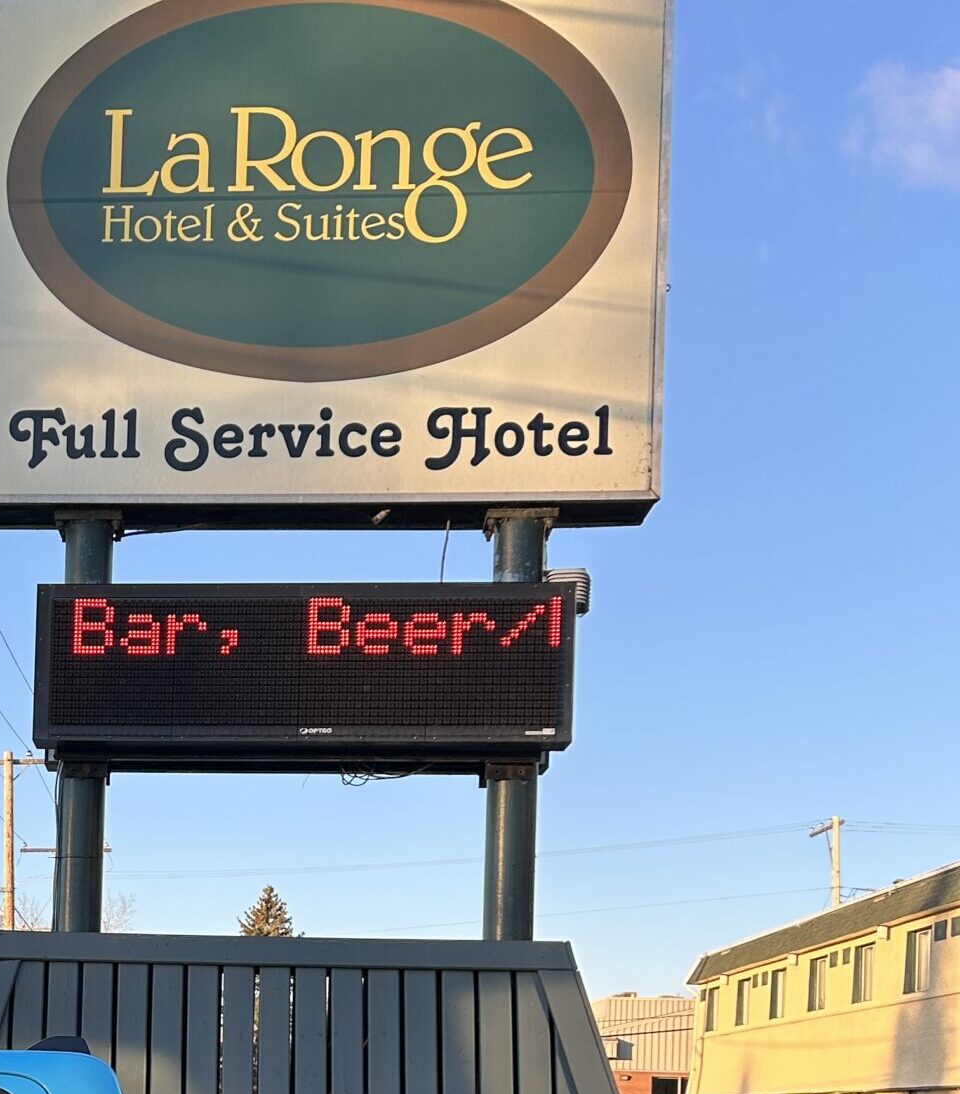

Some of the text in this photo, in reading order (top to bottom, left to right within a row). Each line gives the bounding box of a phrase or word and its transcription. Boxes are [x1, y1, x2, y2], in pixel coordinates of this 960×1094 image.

[102, 106, 534, 244] La Ronge
[103, 202, 405, 243] Hotel & Suites
[8, 404, 613, 472] Full Service Hotel
[72, 598, 239, 656] Bar,
